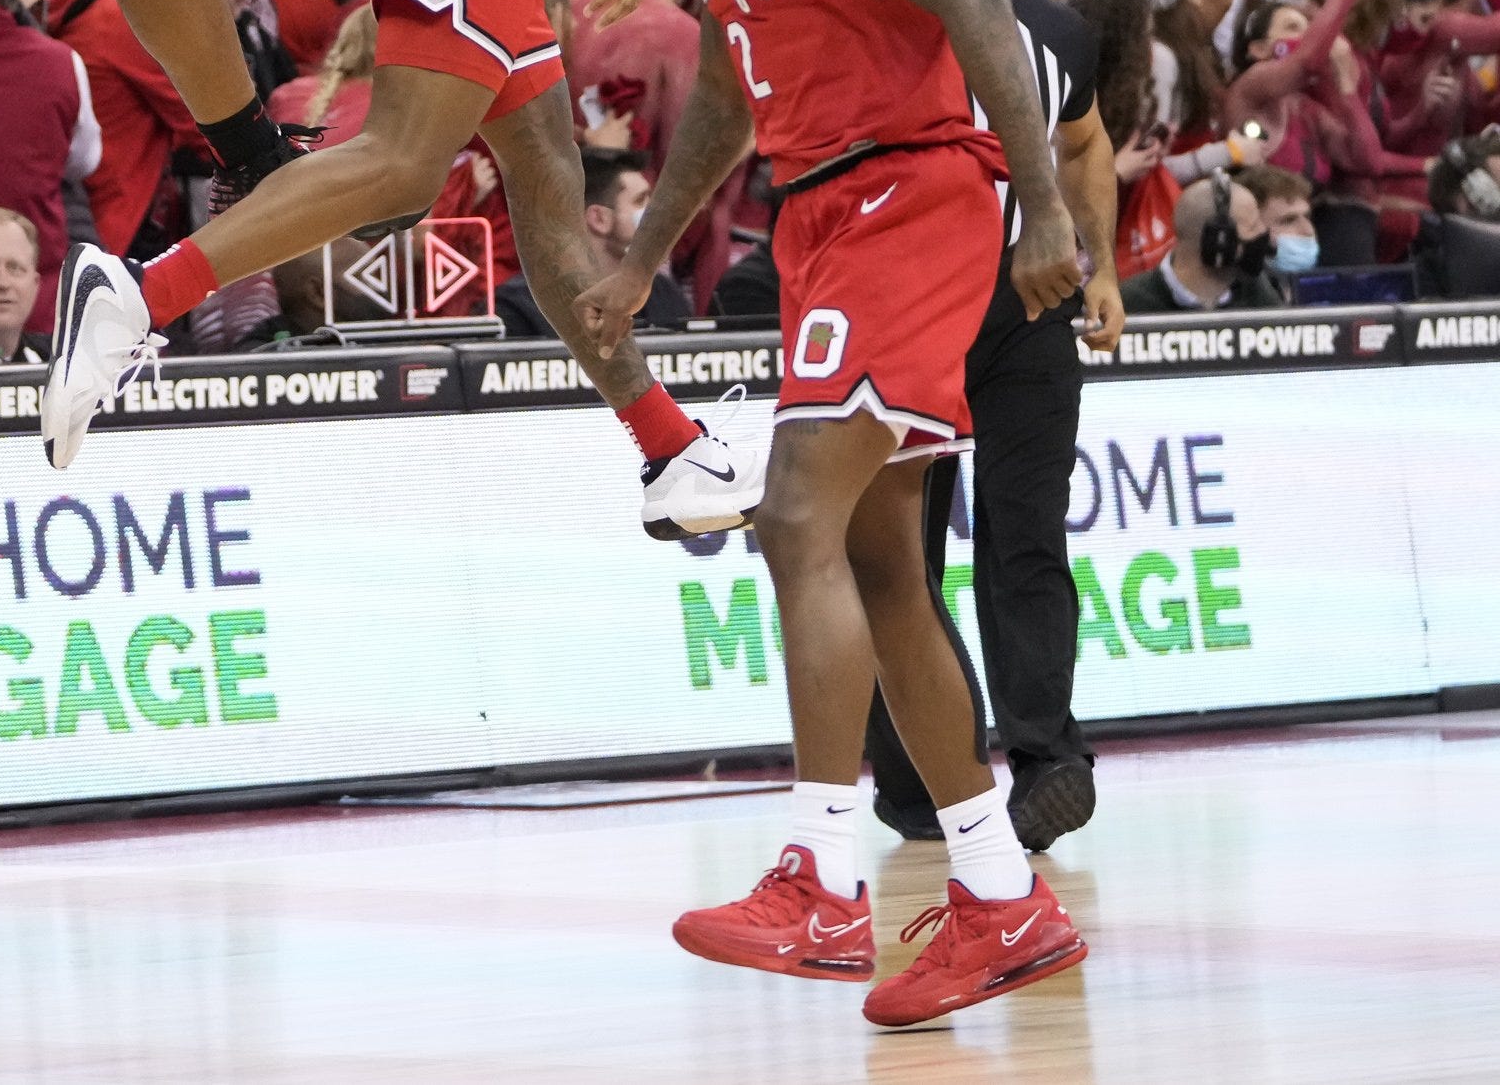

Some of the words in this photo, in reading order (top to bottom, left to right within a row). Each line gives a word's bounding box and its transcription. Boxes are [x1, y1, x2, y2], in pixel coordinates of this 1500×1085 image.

[727, 21, 773, 100] 2
[1120, 327, 1234, 363] ELECTRIC
[1240, 324, 1336, 359] POWER
[124, 375, 259, 413] ELECTRIC
[266, 370, 379, 406] POWER
[480, 358, 596, 394] AMERIC
